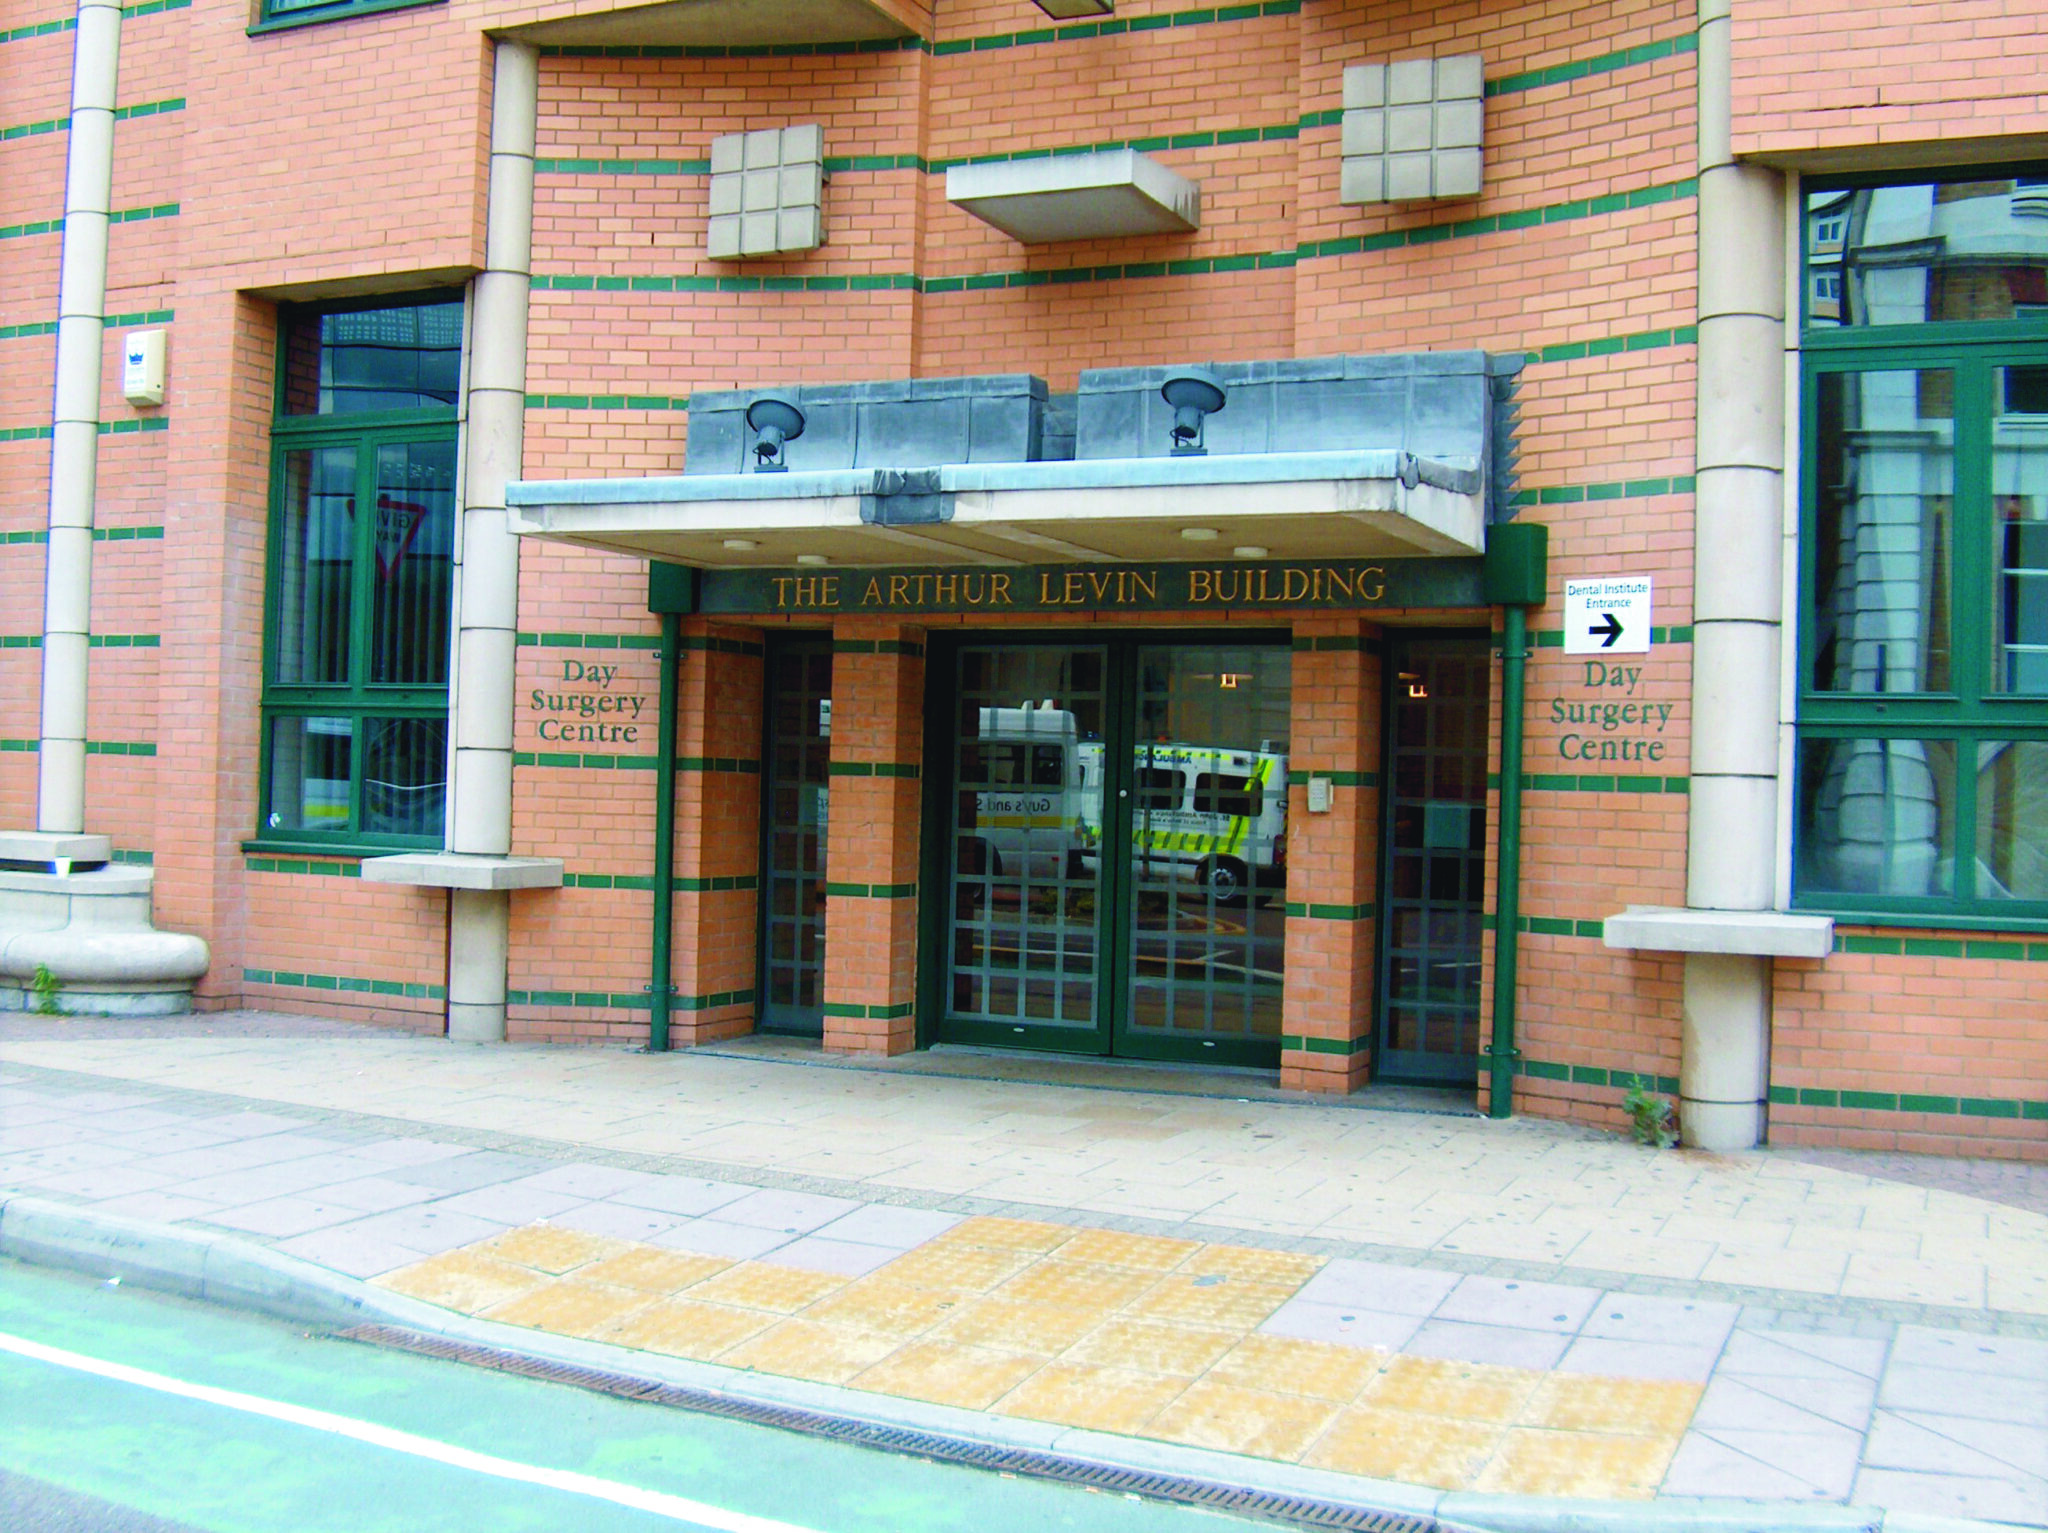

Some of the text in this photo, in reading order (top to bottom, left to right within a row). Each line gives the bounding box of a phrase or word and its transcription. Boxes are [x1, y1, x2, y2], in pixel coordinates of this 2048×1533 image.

[772, 566, 1386, 607] THE ARTHUR LEVIN BUILDING
[1568, 582, 1648, 596] Dental Institute
[1586, 598, 1632, 609] Entrance
[562, 659, 617, 688] Day
[1584, 660, 1642, 695] Day
[530, 689, 646, 719] Surgery
[1550, 697, 1673, 732] Surgery
[538, 718, 638, 743] Centre
[1559, 733, 1664, 761] Centre
